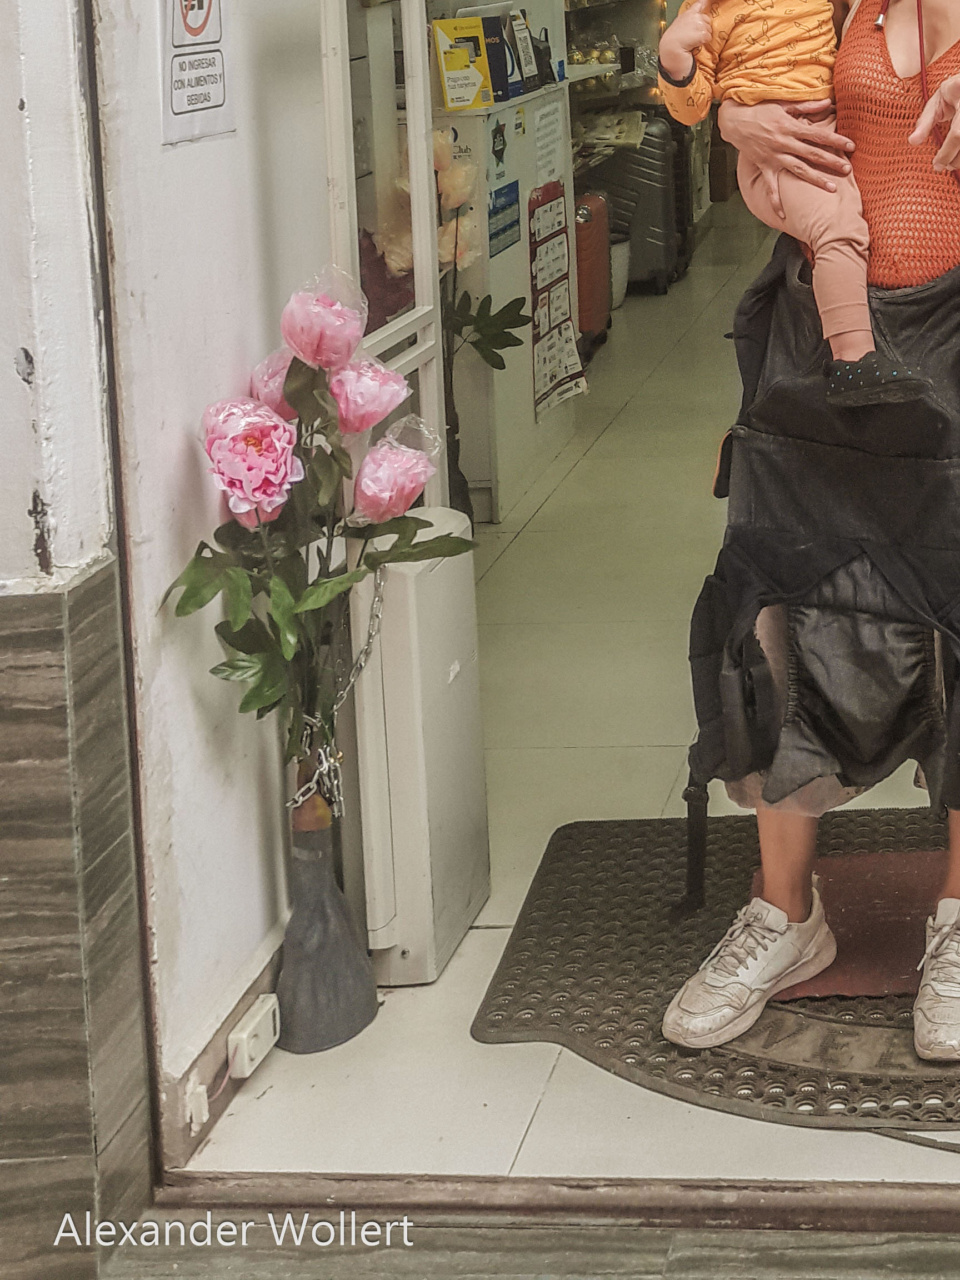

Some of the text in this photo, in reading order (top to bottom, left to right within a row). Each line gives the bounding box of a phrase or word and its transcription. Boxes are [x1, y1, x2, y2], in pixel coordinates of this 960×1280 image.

[178, 57, 216, 72] NO INGRESAR
[173, 79, 186, 91] CON
[187, 74, 218, 88] ALIMENTOS
[187, 91, 211, 106] BEBIDAS
